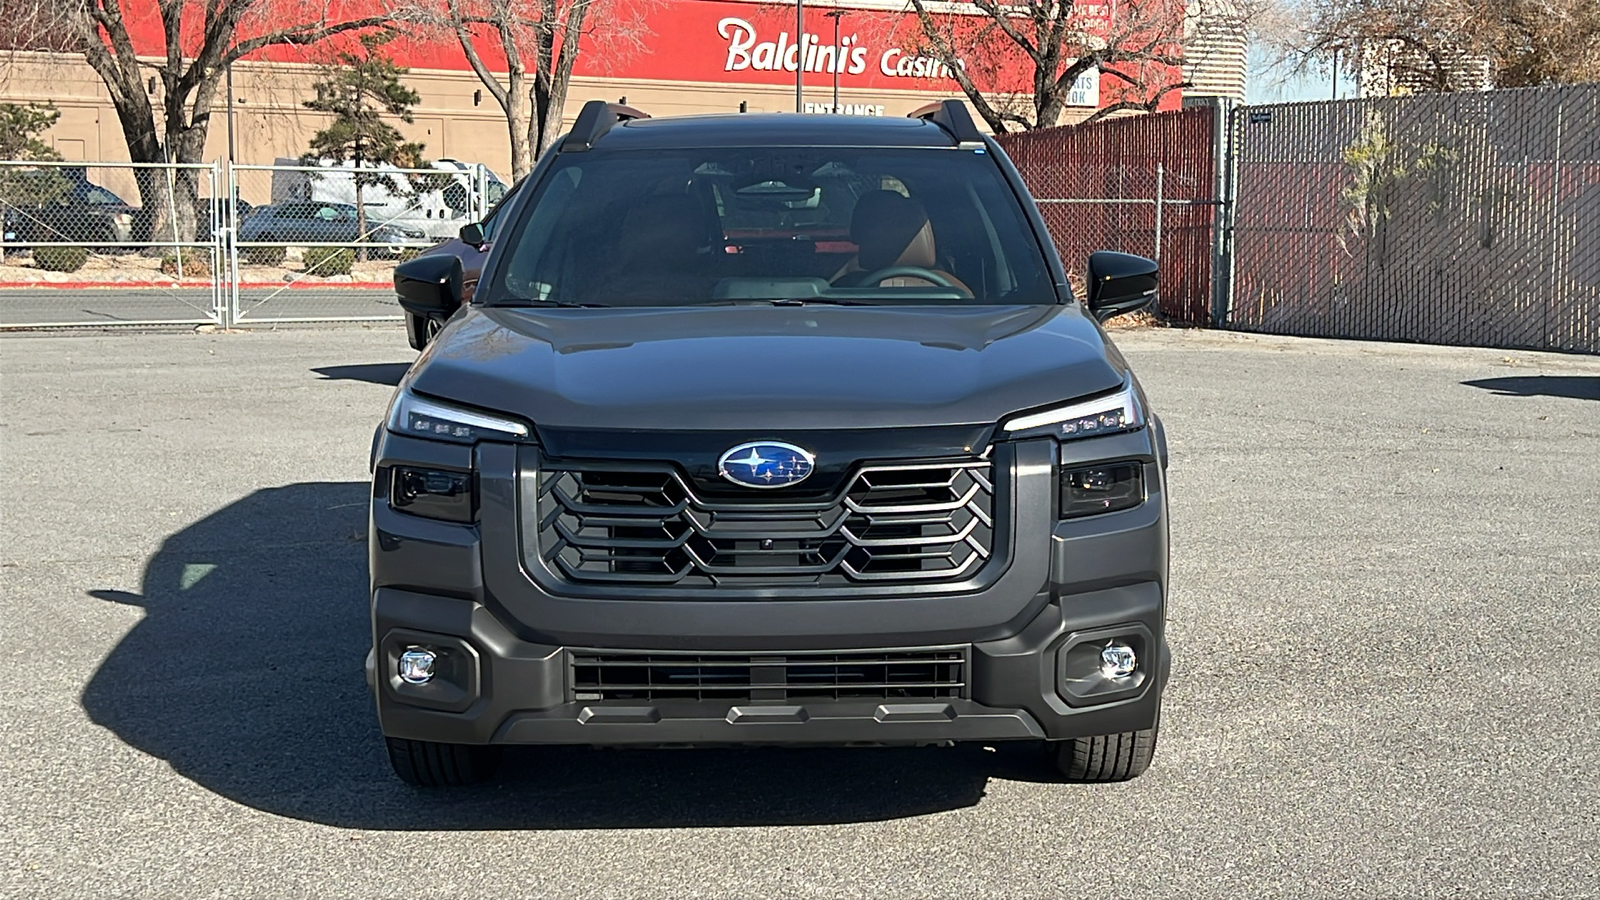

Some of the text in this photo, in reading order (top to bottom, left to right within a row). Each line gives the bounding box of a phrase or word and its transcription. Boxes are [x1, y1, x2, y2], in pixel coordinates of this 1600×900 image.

[1088, 4, 1109, 16] BEST
[717, 17, 867, 75] Baldini's
[804, 102, 885, 117] ENTRANCE
